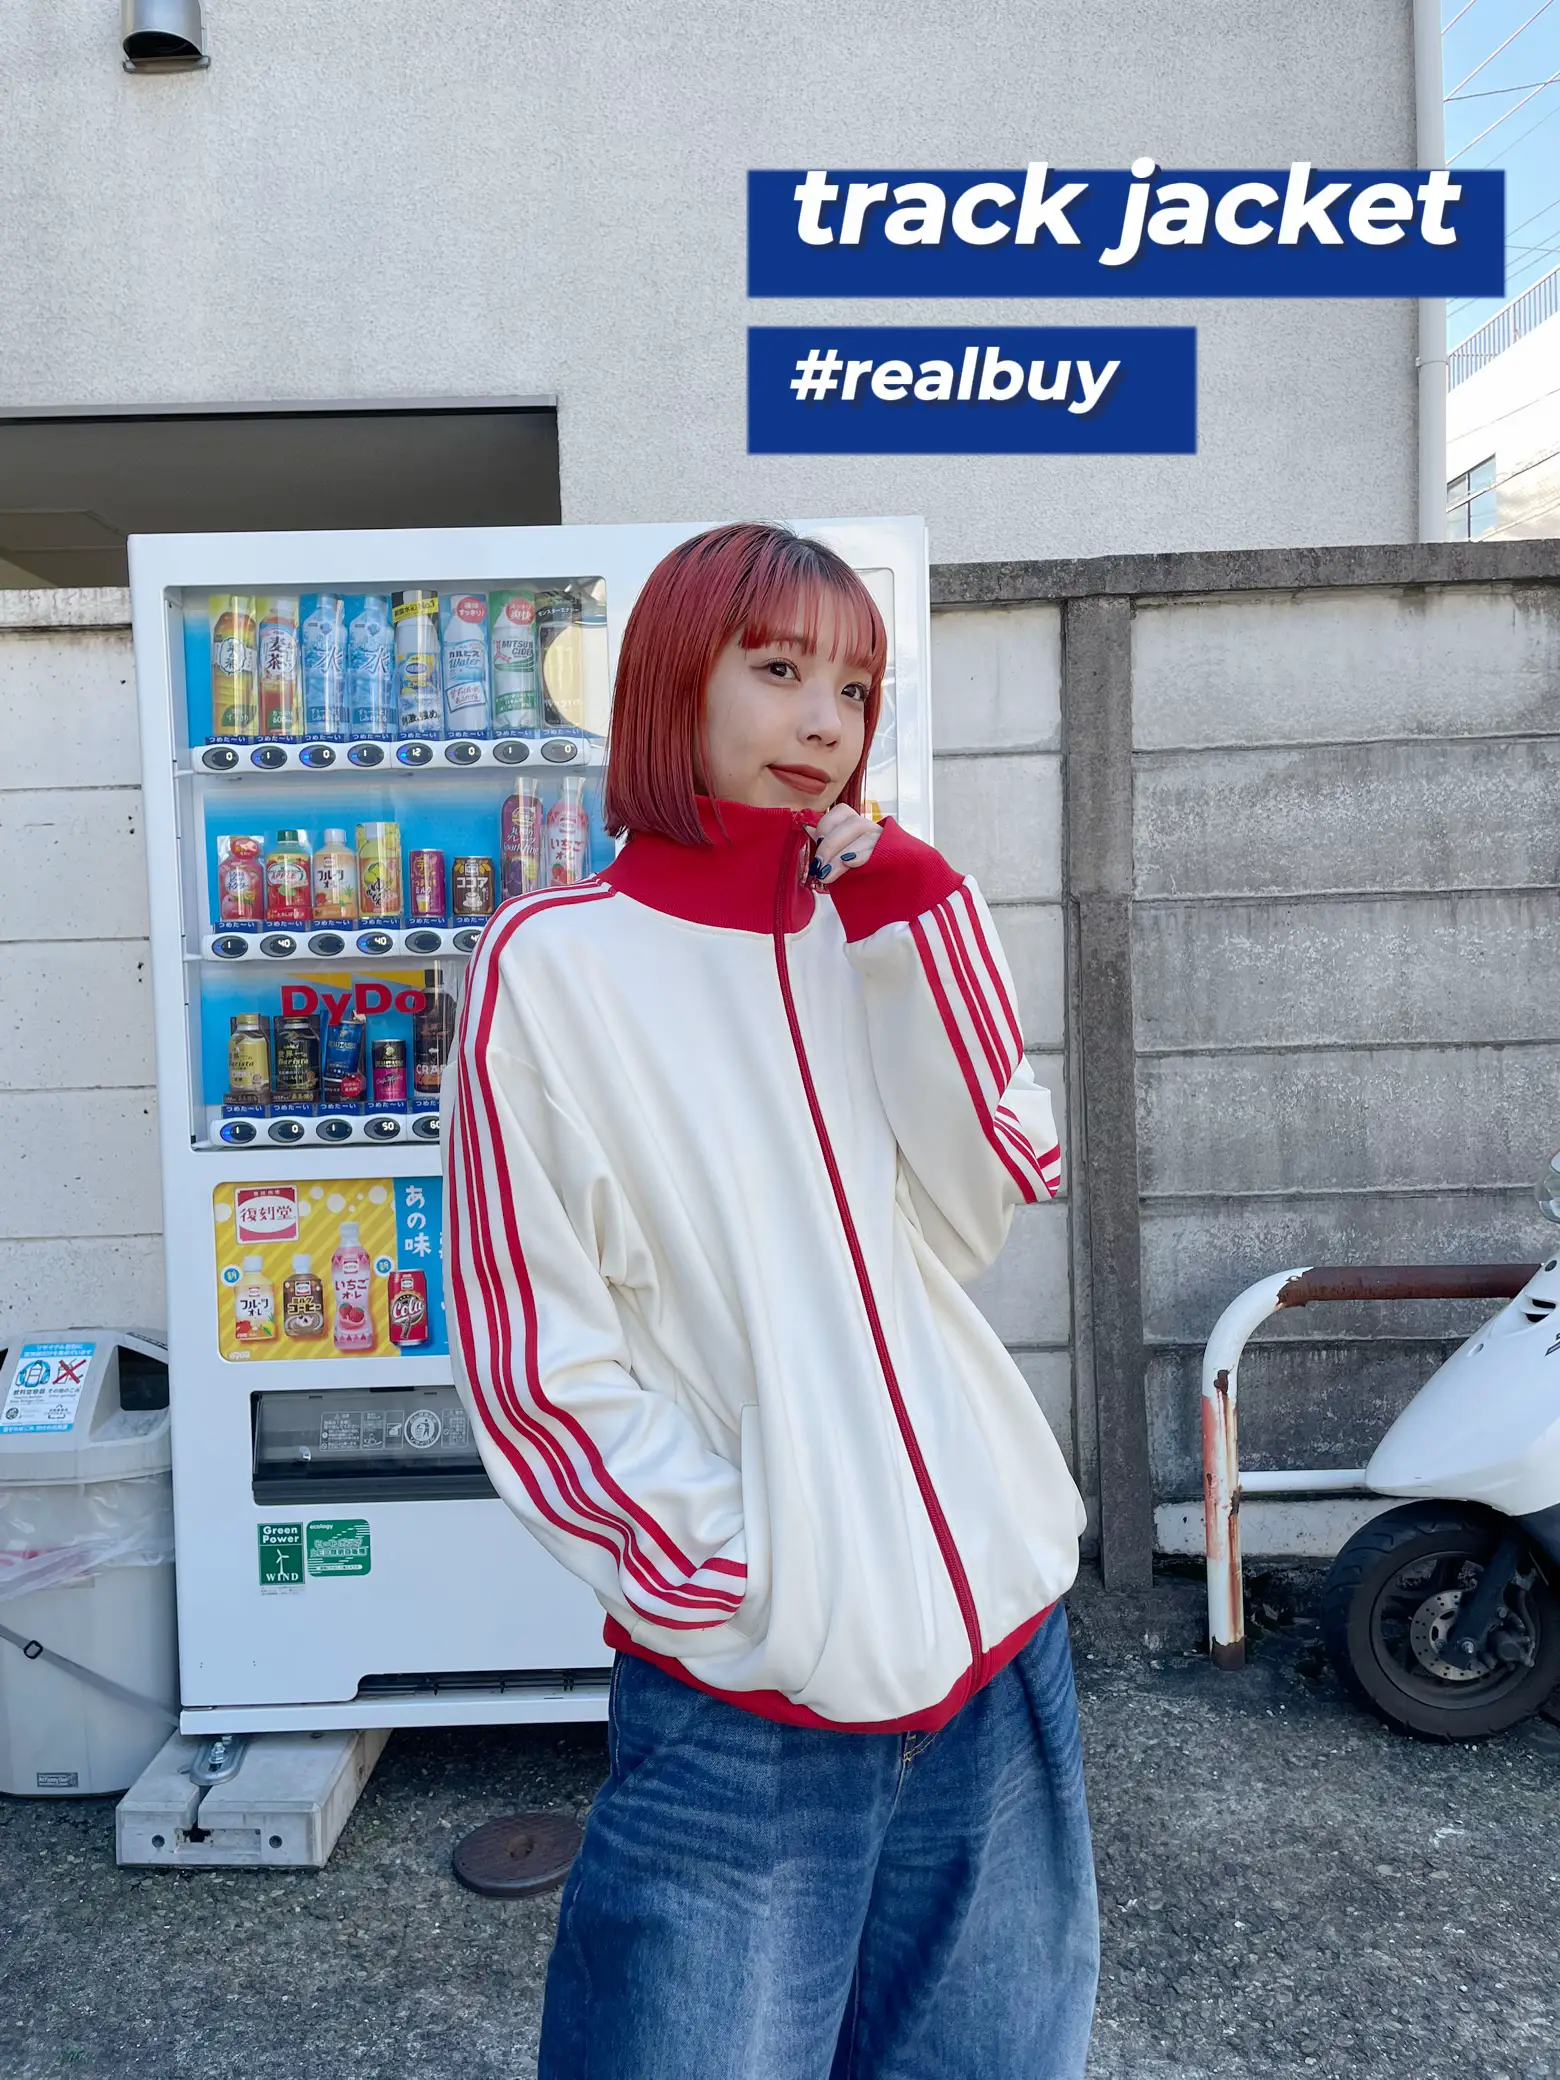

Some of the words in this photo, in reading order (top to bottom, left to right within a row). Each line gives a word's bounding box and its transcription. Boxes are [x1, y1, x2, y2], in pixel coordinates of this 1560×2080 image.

[268, 636, 282, 670] 麦茶
[448, 650, 480, 658] カルピス
[360, 647, 390, 674] 水
[456, 877, 489, 889] ココア
[374, 936, 387, 945] 40
[281, 983, 427, 1026] DyDo
[382, 1122, 395, 1131] 50
[240, 1206, 293, 1222] 復刻堂
[404, 1185, 432, 1257] あの味
[335, 1278, 369, 1290] いちご
[240, 1299, 269, 1310] フルーツ
[288, 1303, 321, 1314] コーヒー
[392, 1296, 425, 1319] Cola
[263, 1526, 298, 1535] Green
[262, 1535, 299, 1543] Power
[266, 1573, 299, 1581] WIND
